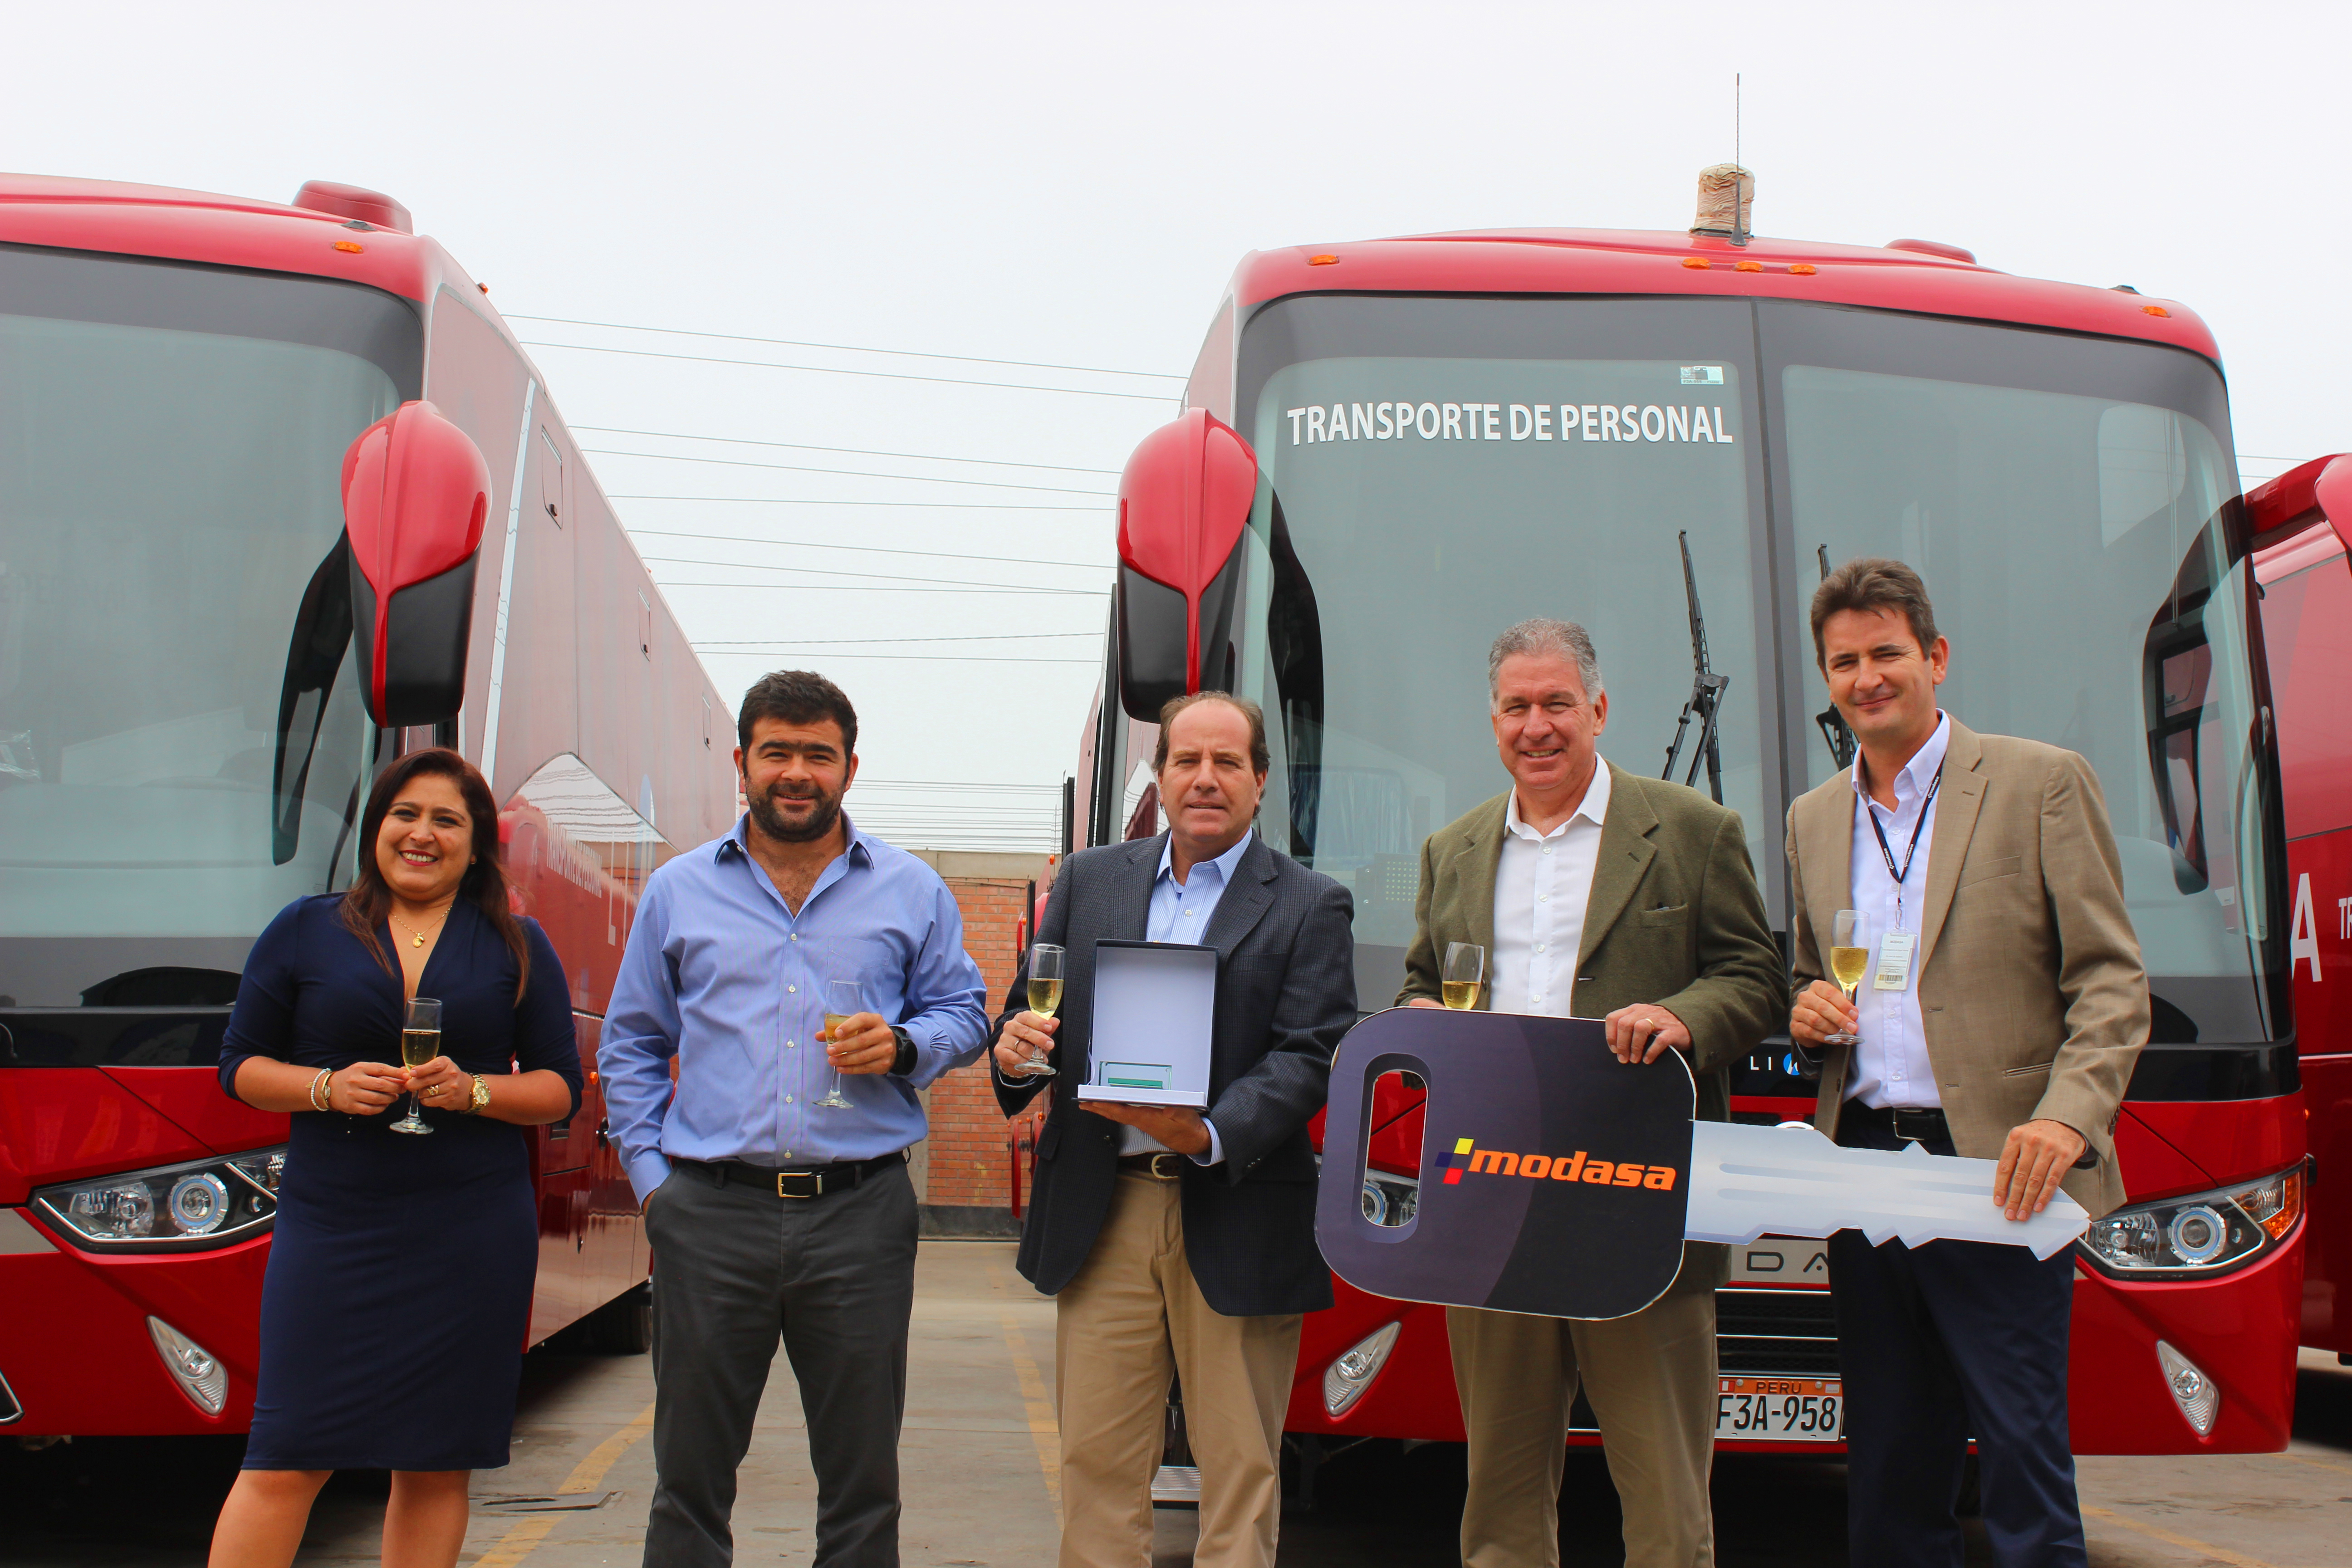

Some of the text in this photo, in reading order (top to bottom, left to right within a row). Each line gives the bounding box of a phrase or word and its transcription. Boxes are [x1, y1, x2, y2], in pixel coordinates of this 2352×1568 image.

[1287, 402, 1733, 446] TRANSPORTE DE PERSONAL
[1467, 1149, 1676, 1191] modasa
[1756, 1380, 1802, 1394] PERU
[1716, 1394, 1837, 1431] F3A-958
